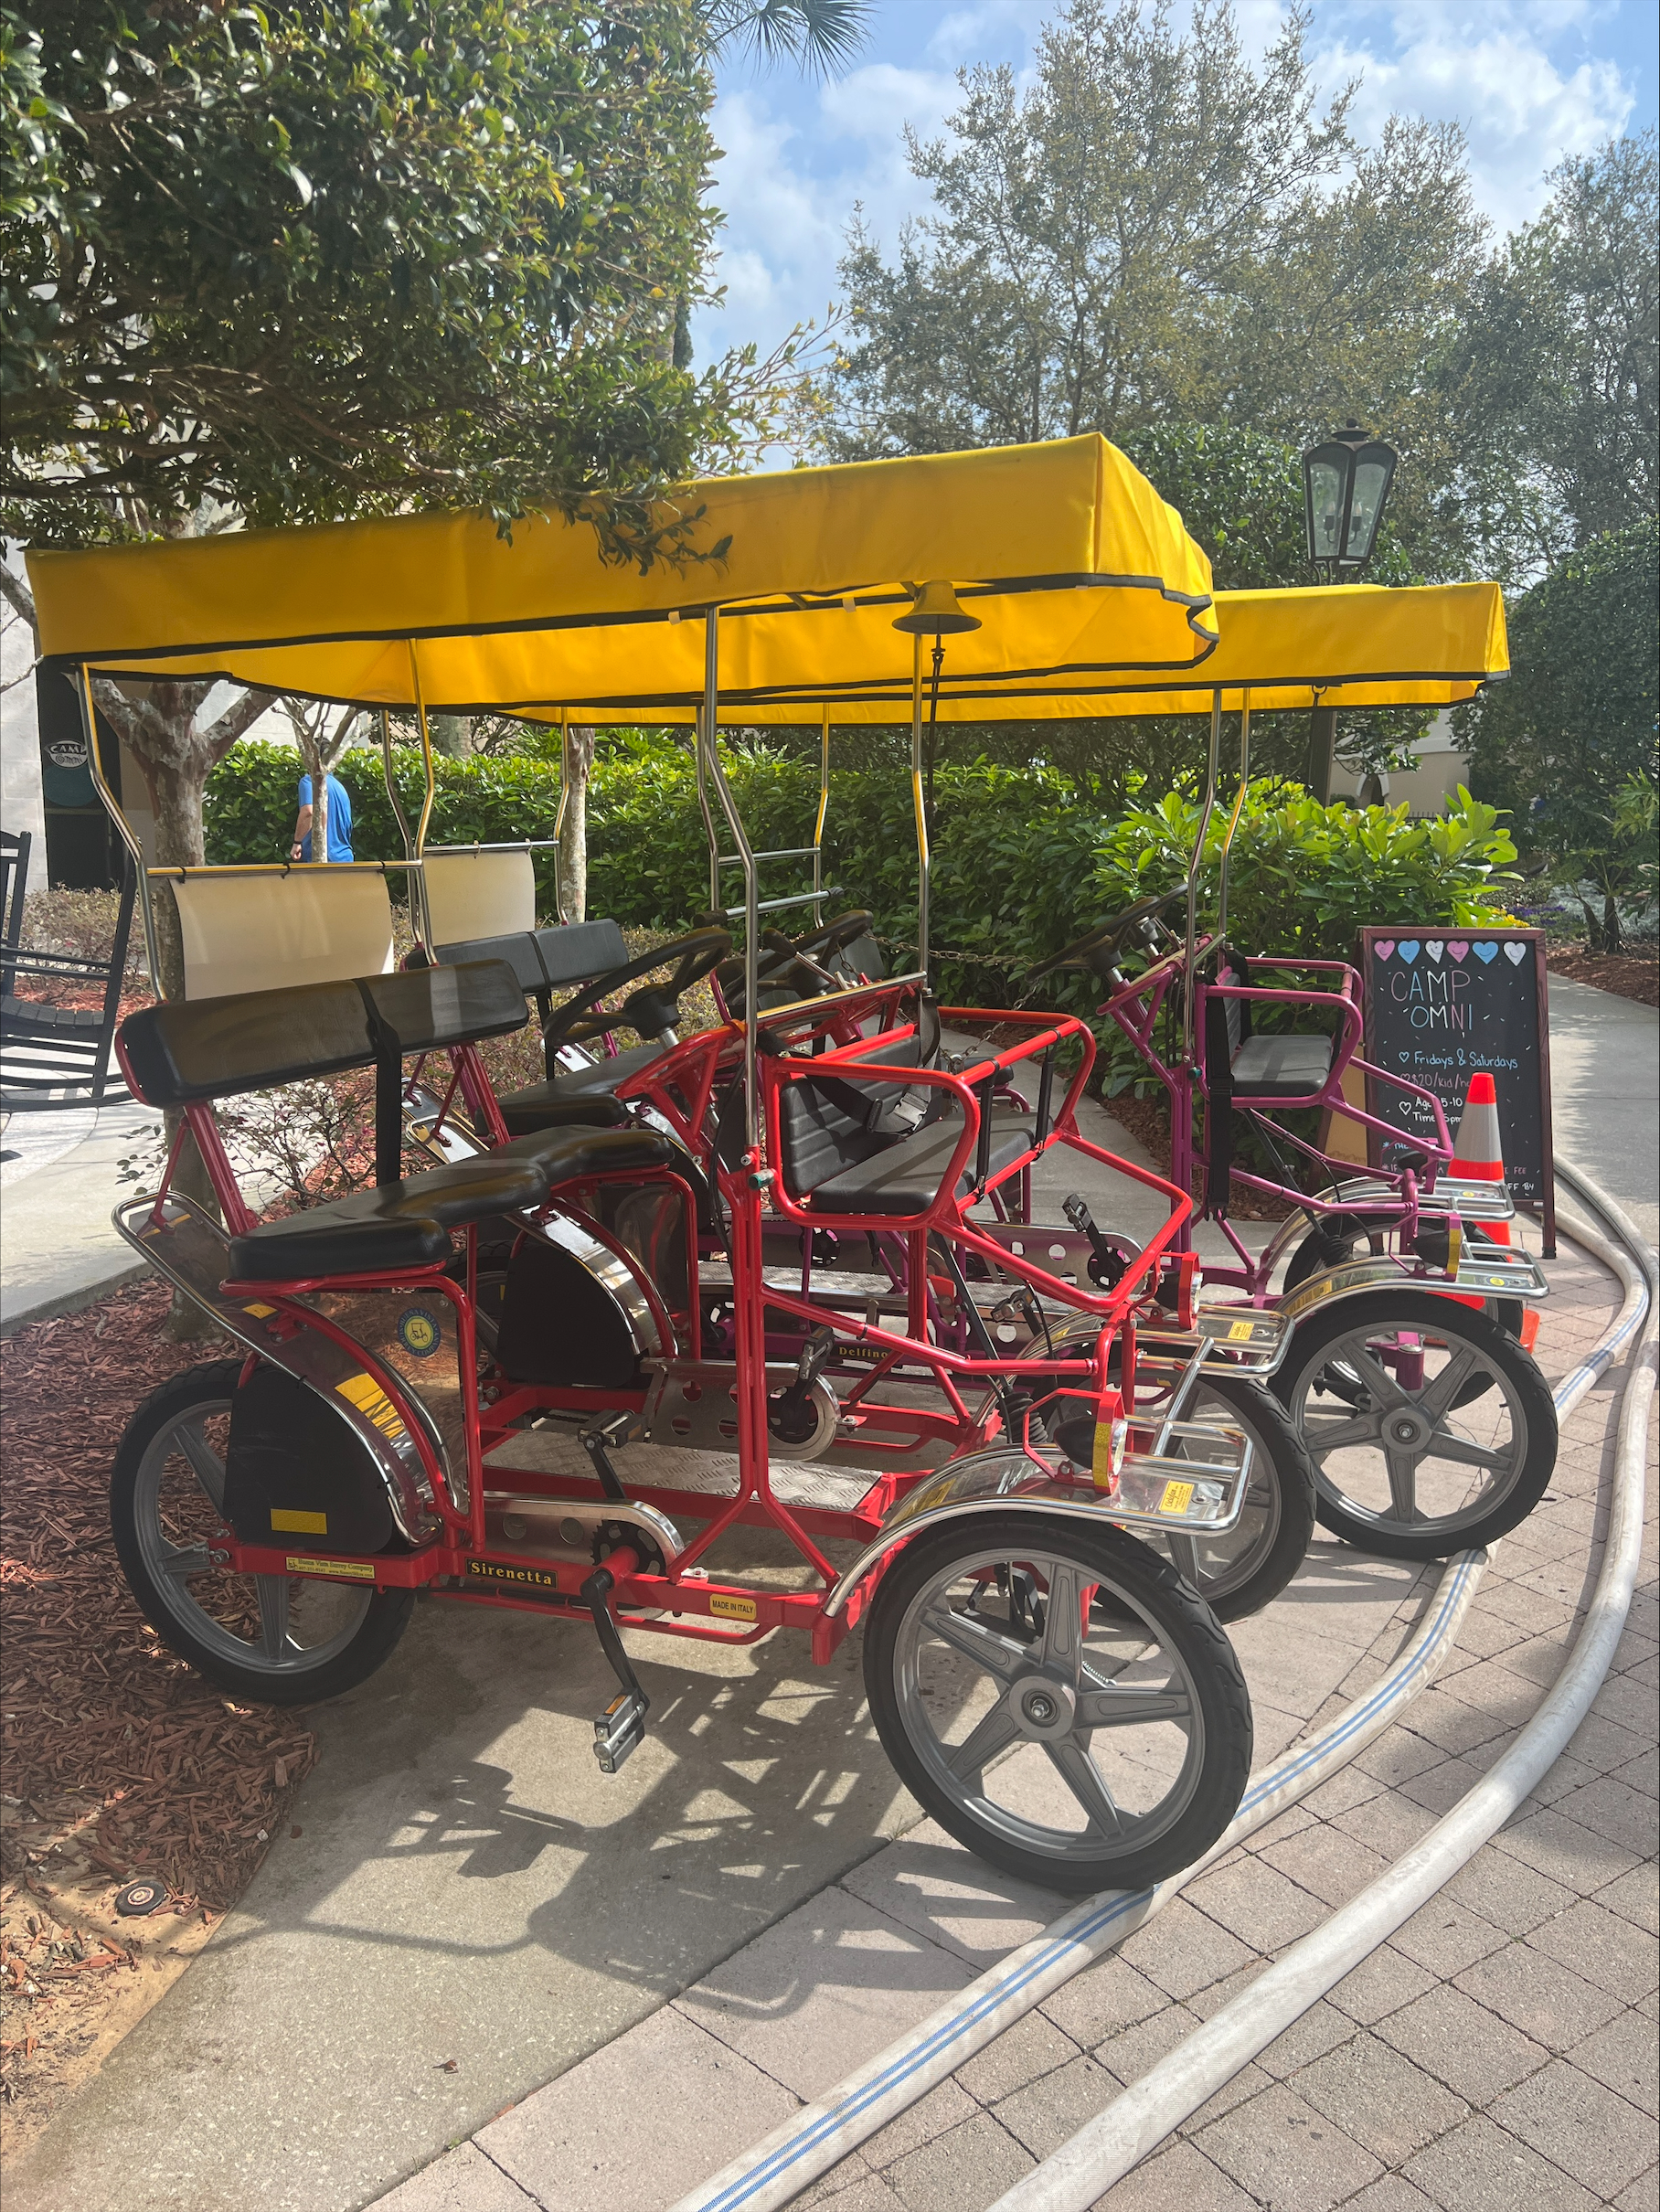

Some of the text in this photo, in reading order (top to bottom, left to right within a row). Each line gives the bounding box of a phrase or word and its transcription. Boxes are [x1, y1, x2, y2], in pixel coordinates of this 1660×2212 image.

[1391, 970, 1471, 1002] CAMP
[1410, 1004, 1473, 1030] OMNI
[1414, 1048, 1518, 1069] Fridays & Saturdays
[1514, 1166, 1527, 1175] FEE
[1506, 1182, 1535, 1191] FF BY
[839, 1346, 889, 1359] Delfino
[329, 1561, 347, 1570] Surrey
[348, 1564, 373, 1572] Company
[471, 1562, 552, 1585] Sirenetta
[712, 1600, 753, 1613] MADE IN ITALY
